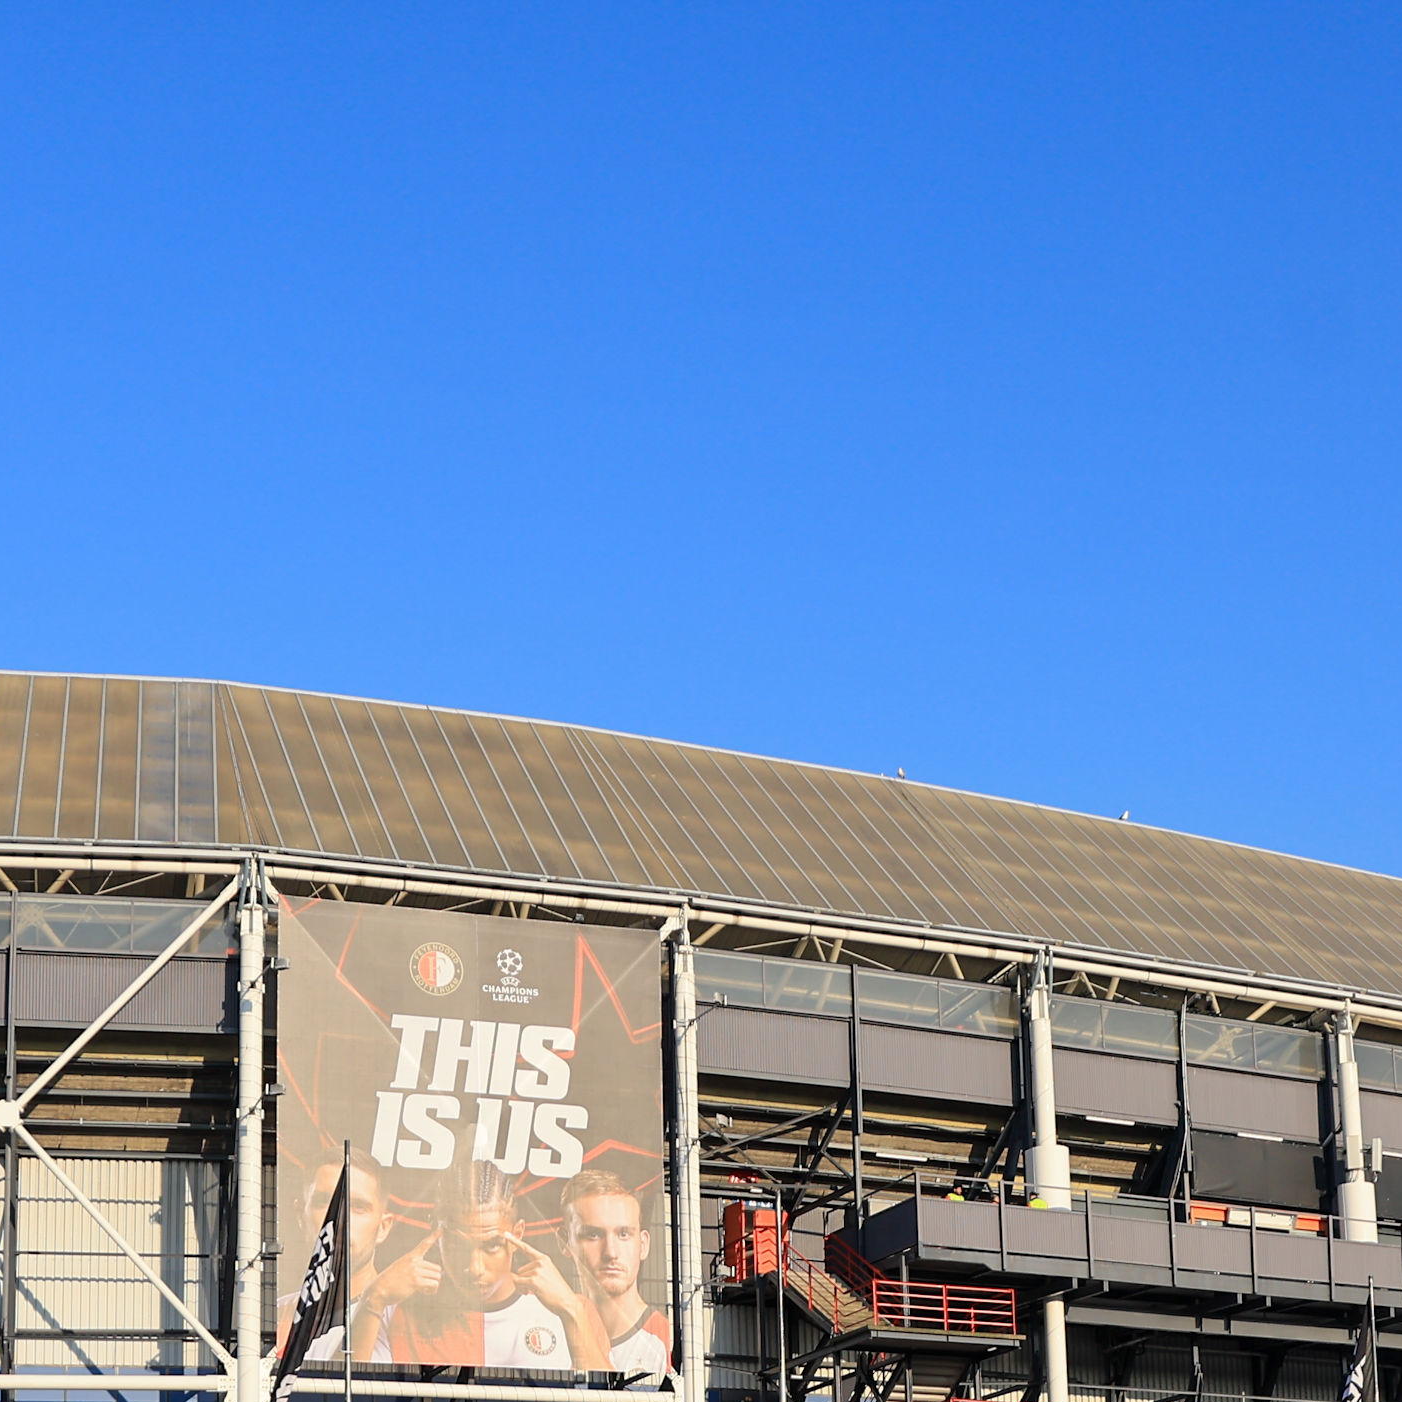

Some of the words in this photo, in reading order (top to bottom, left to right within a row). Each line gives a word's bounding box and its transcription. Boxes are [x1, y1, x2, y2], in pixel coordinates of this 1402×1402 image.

[482, 984, 539, 997] CHAMPIONS
[492, 993, 530, 1004] LEAGUE
[389, 1014, 576, 1100] THIS
[369, 1090, 462, 1170] IS
[472, 1097, 589, 1179] US
